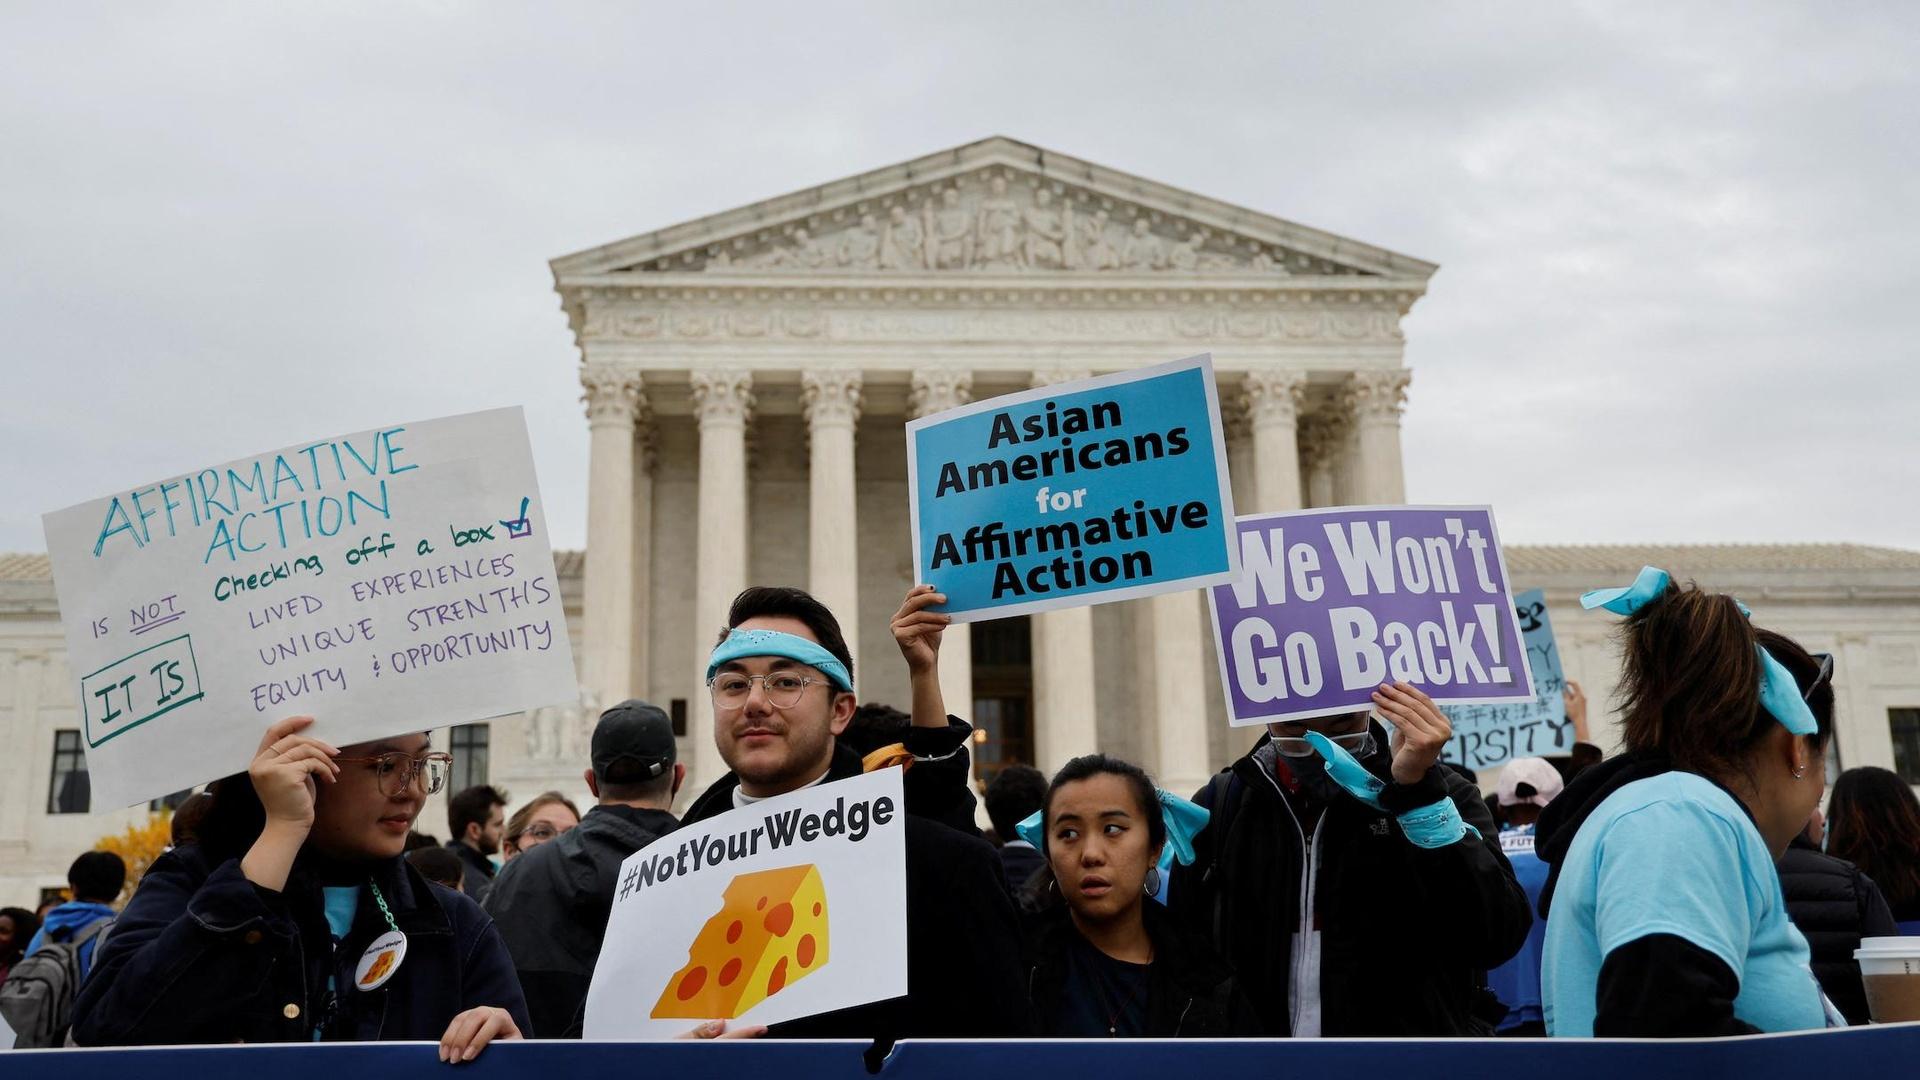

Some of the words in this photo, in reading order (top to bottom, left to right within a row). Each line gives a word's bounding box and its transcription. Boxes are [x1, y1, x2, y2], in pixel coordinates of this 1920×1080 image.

[936, 426, 1190, 498] Americans
[988, 401, 1122, 449] Asian
[93, 427, 419, 557] AFFIRMATIVE
[204, 480, 391, 564] ACTION
[1036, 486, 1087, 514] for
[214, 553, 324, 600] Checking
[346, 532, 395, 567] off
[417, 537, 433, 556] a
[450, 520, 495, 548] box
[931, 500, 1209, 570] Affirmative
[992, 546, 1153, 599] Action
[1232, 528, 1324, 608] We
[1324, 518, 1498, 597] Won't
[92, 617, 108, 638] IS
[131, 597, 179, 628] NOT
[249, 595, 323, 628] LIVED
[352, 554, 515, 600] EXPERIENCES
[260, 618, 376, 666] UNIQUE
[407, 577, 551, 632] STRENTHS
[253, 668, 348, 713] EQUITY
[391, 620, 552, 674] OPPORTUNITY
[1231, 617, 1323, 703] Go
[1329, 600, 1513, 691] Back!
[95, 675, 137, 723] IT
[150, 658, 185, 704] IS
[619, 796, 894, 902] #NotYourWedge
